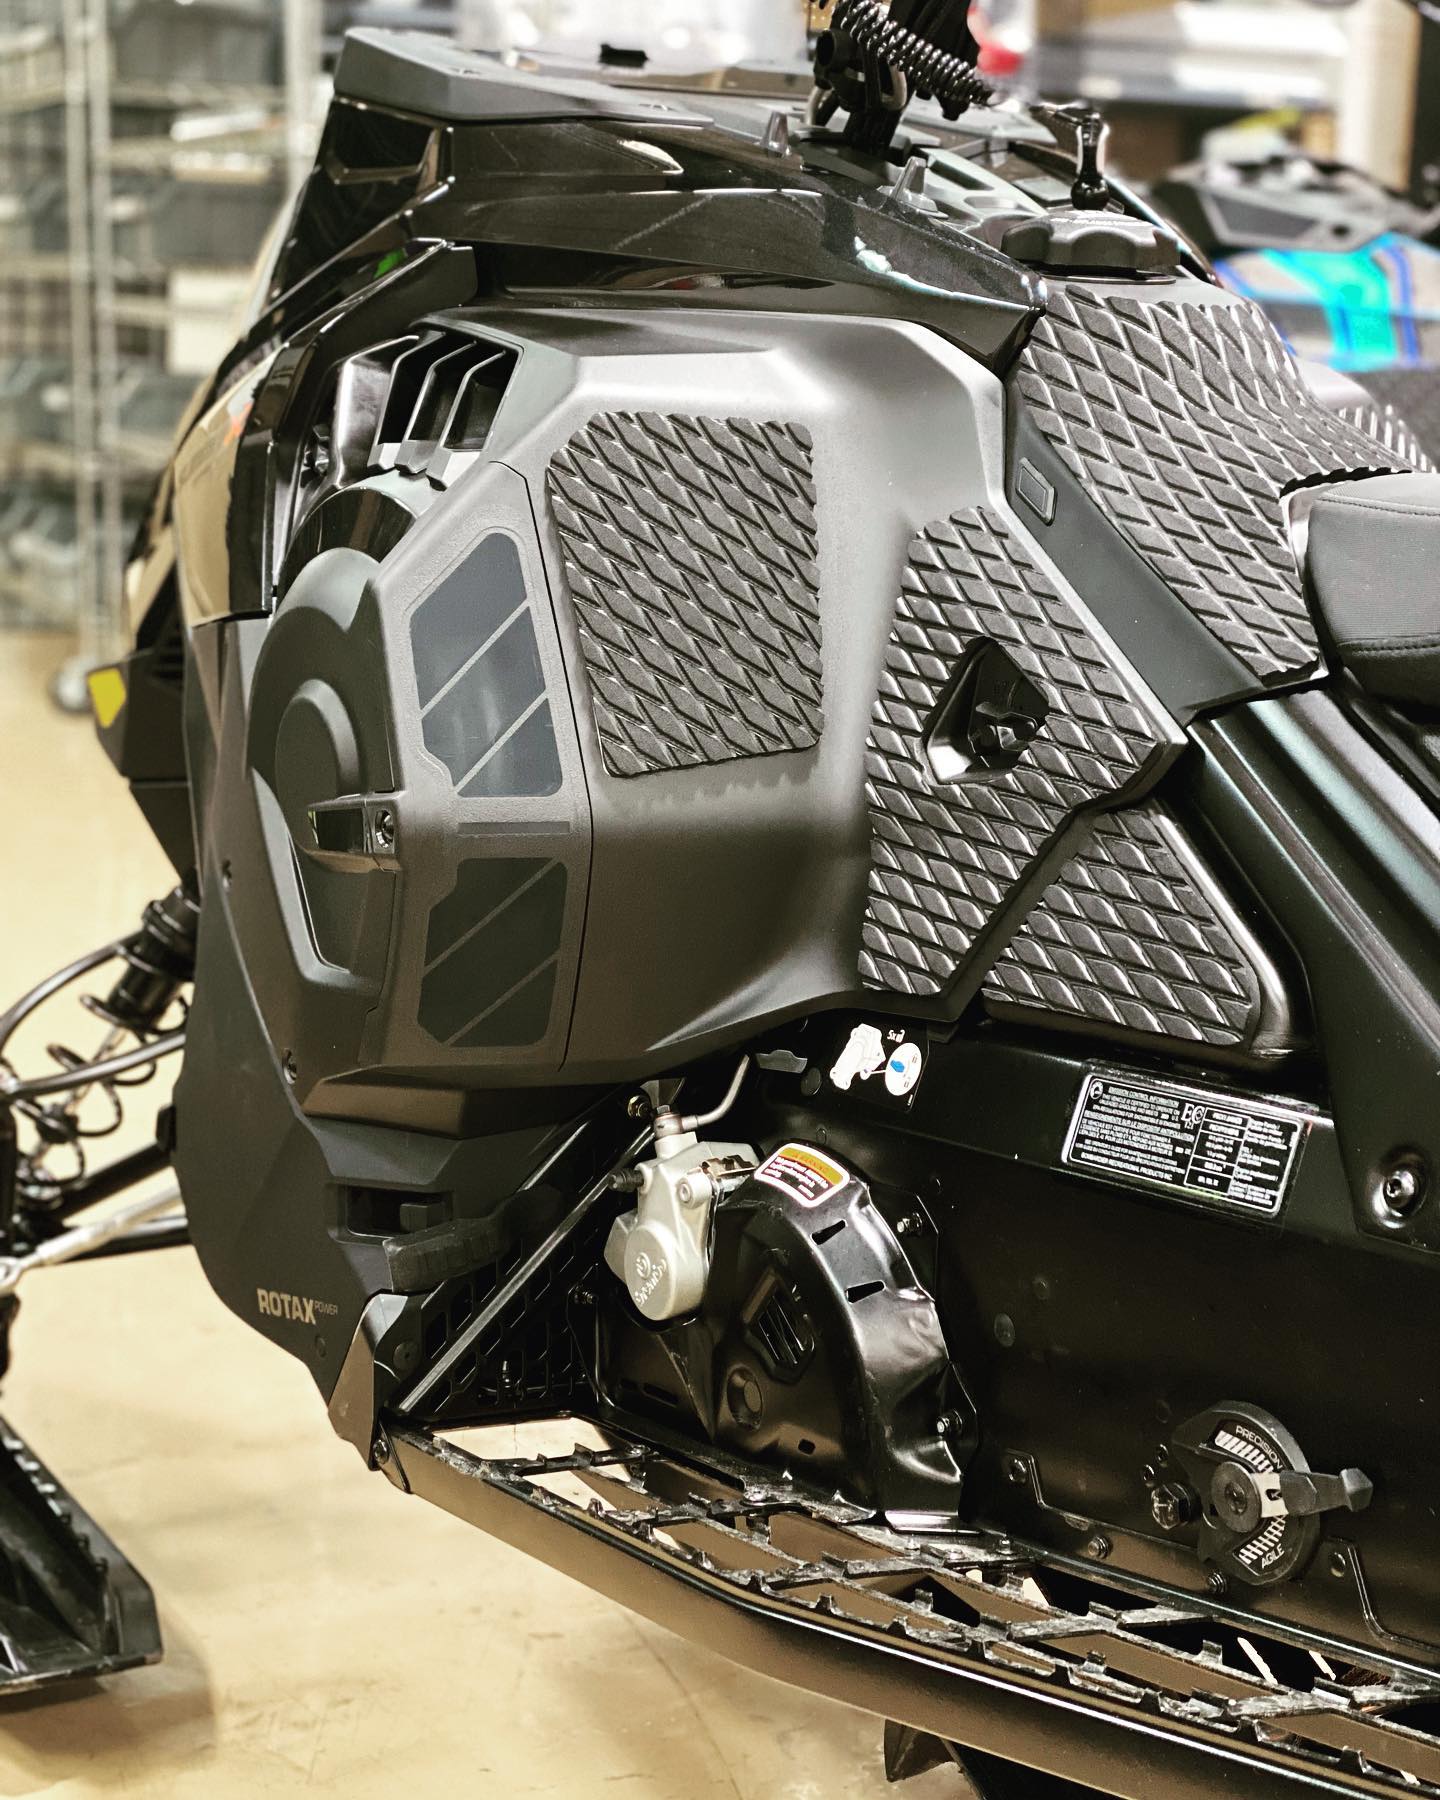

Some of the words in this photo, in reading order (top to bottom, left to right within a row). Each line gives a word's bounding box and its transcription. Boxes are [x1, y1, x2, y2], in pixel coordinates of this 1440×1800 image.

[257, 1288, 317, 1325] ROTAX
[314, 1300, 338, 1316] POWER
[1235, 1424, 1284, 1470] PRECISION
[1260, 1543, 1285, 1569] AGILE
